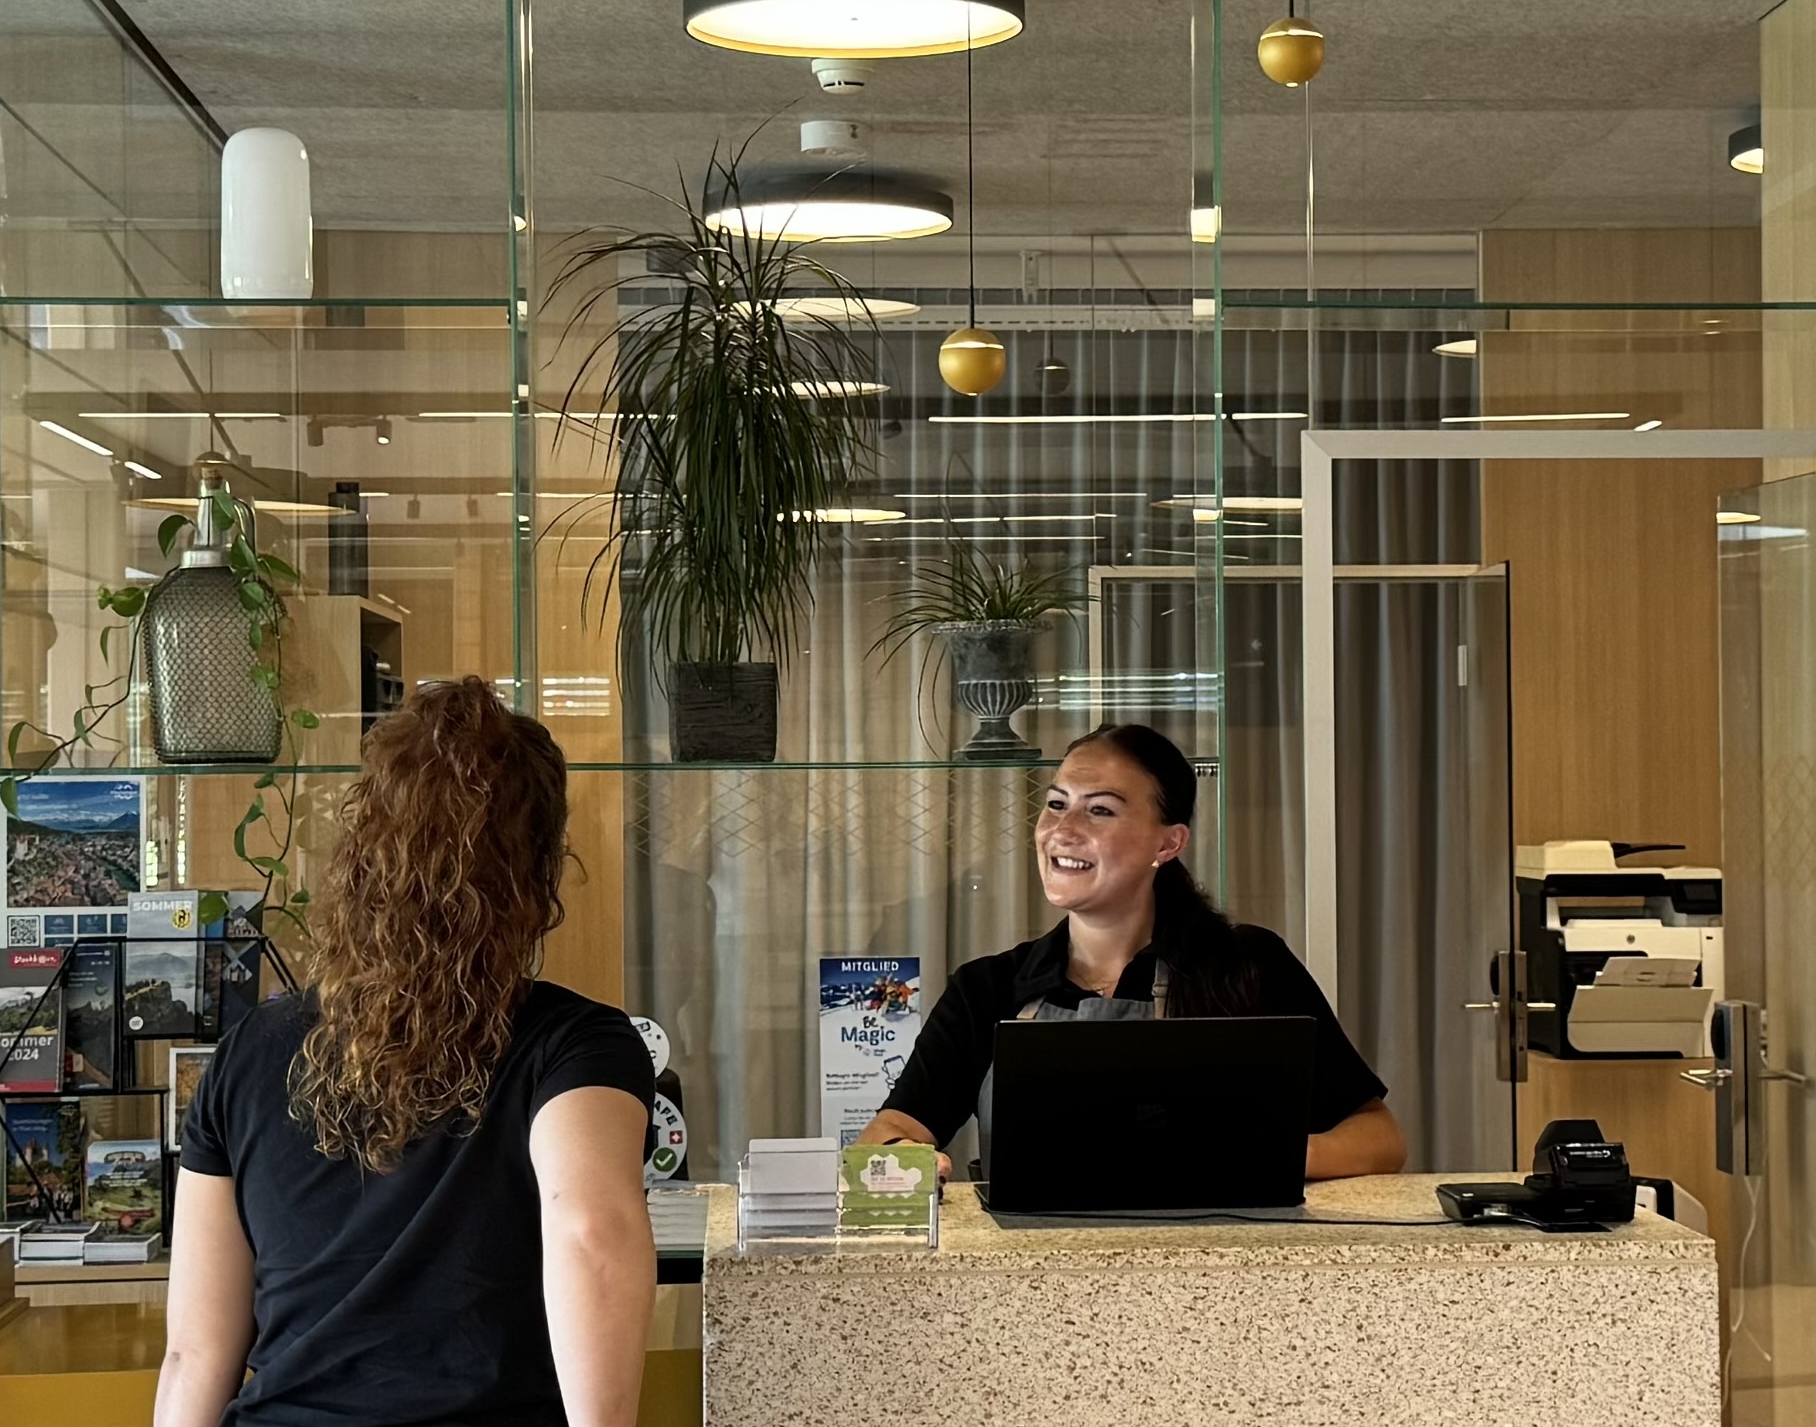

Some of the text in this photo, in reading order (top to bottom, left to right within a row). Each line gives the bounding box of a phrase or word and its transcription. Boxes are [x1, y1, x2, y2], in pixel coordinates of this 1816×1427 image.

[132, 900, 193, 912] SOMMER
[841, 961, 899, 972] MITGLIED
[841, 1026, 896, 1046] Magic
